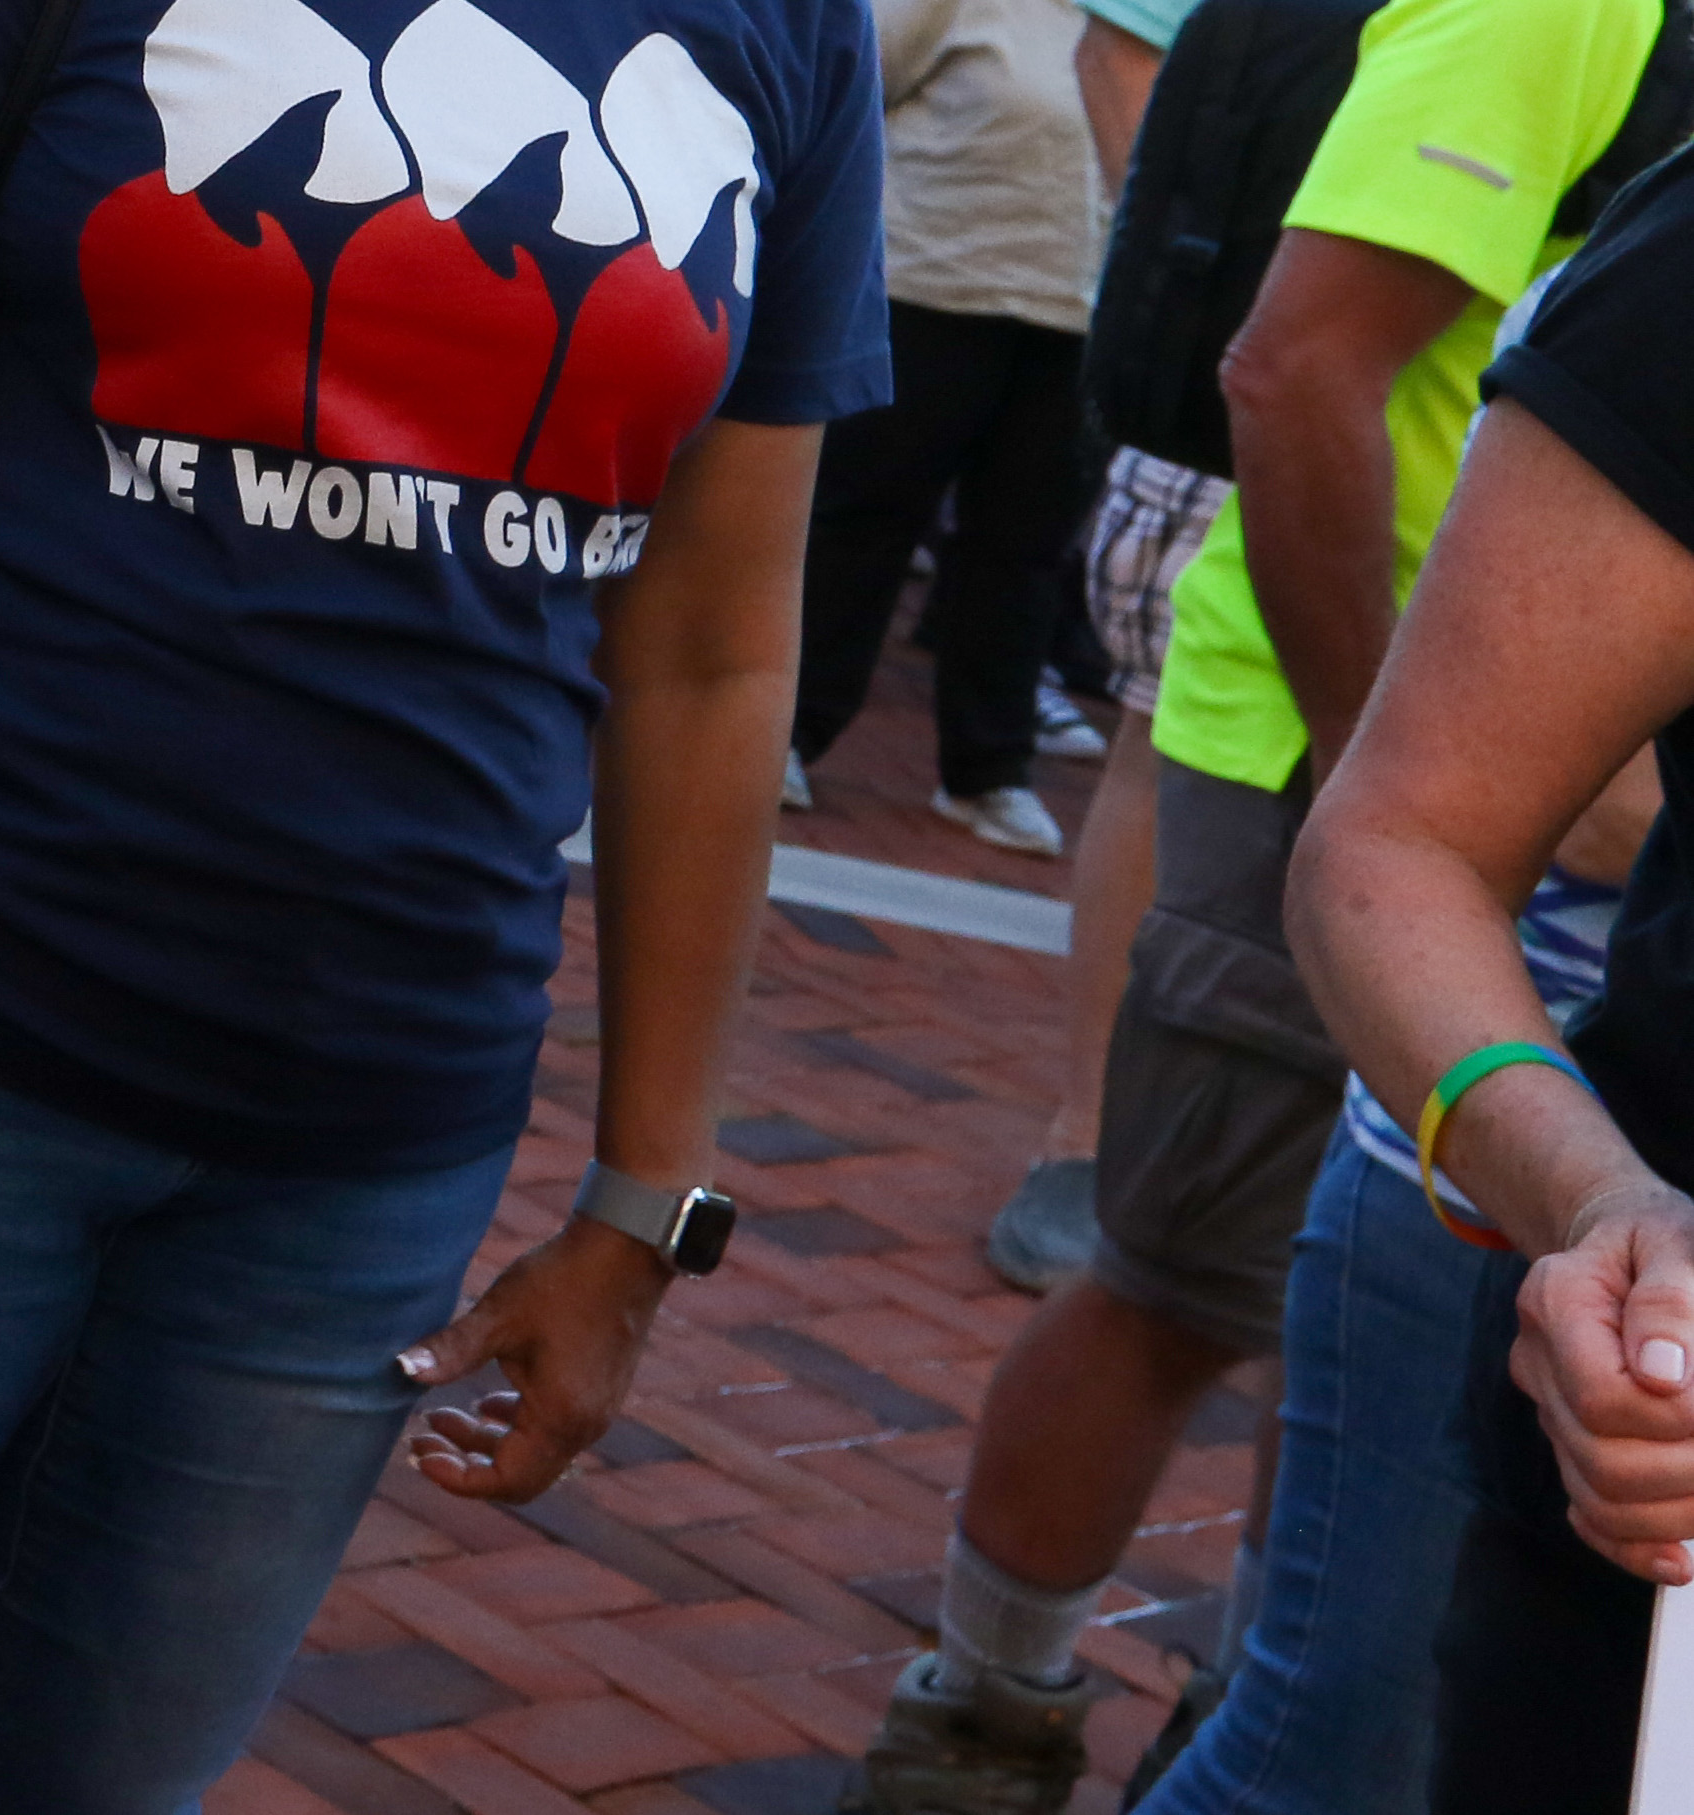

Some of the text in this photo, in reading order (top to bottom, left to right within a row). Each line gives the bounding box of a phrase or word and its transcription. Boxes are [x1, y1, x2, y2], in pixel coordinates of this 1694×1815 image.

[96, 422, 201, 515] WE
[231, 447, 461, 555] WON'T
[483, 489, 568, 575] GO
